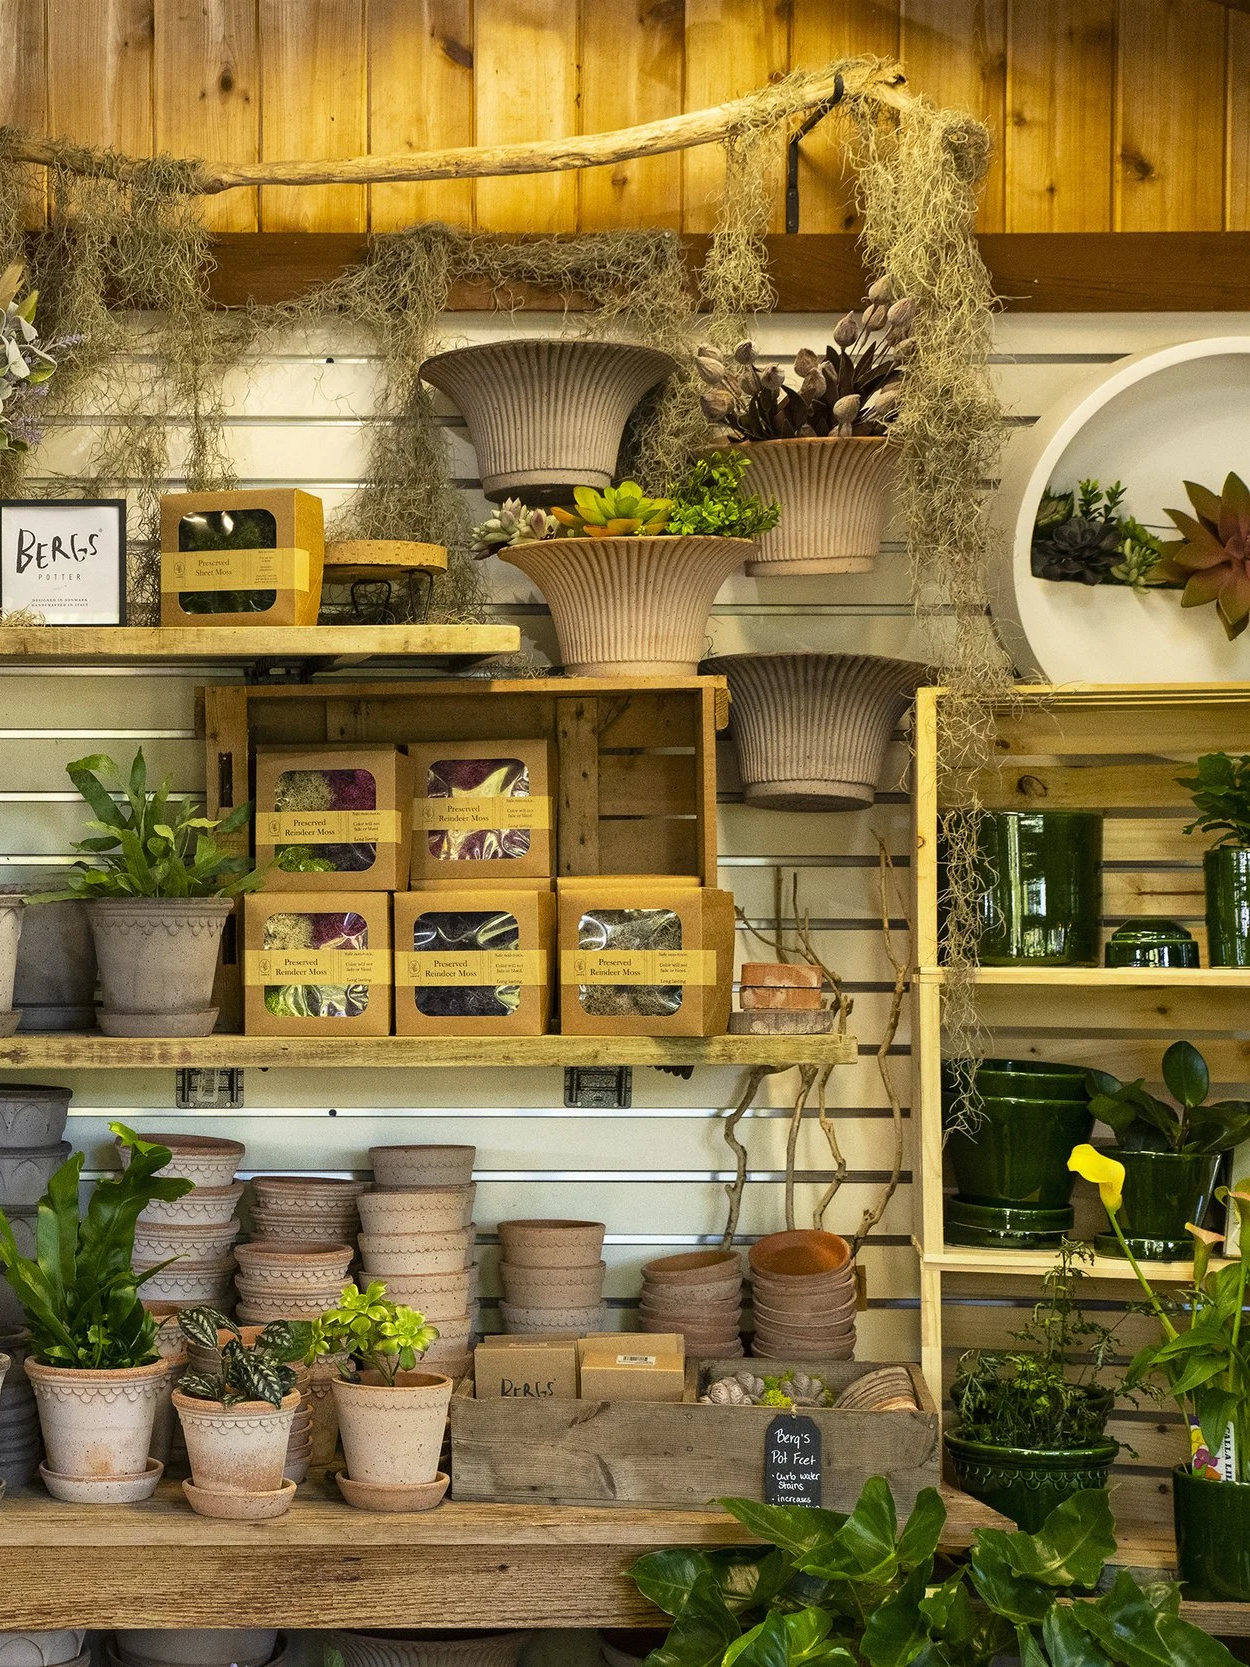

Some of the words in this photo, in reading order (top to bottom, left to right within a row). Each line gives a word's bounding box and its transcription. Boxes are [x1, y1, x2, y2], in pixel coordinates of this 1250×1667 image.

[16, 528, 99, 574] BERGS
[198, 559, 230, 567] Preserved
[195, 568, 213, 577] Sheet
[214, 568, 232, 576] Moss
[447, 805, 480, 813] Preserved
[285, 829, 315, 837] Reindeer
[284, 958, 318, 966] Preserved
[434, 960, 468, 968] Preserved
[275, 968, 307, 976] Reindeer
[425, 970, 456, 978] Reindeer
[771, 1450, 788, 1464] Pot
[793, 1452, 816, 1465] Feet
[800, 1472, 820, 1480] water
[777, 1495, 811, 1503] increases
